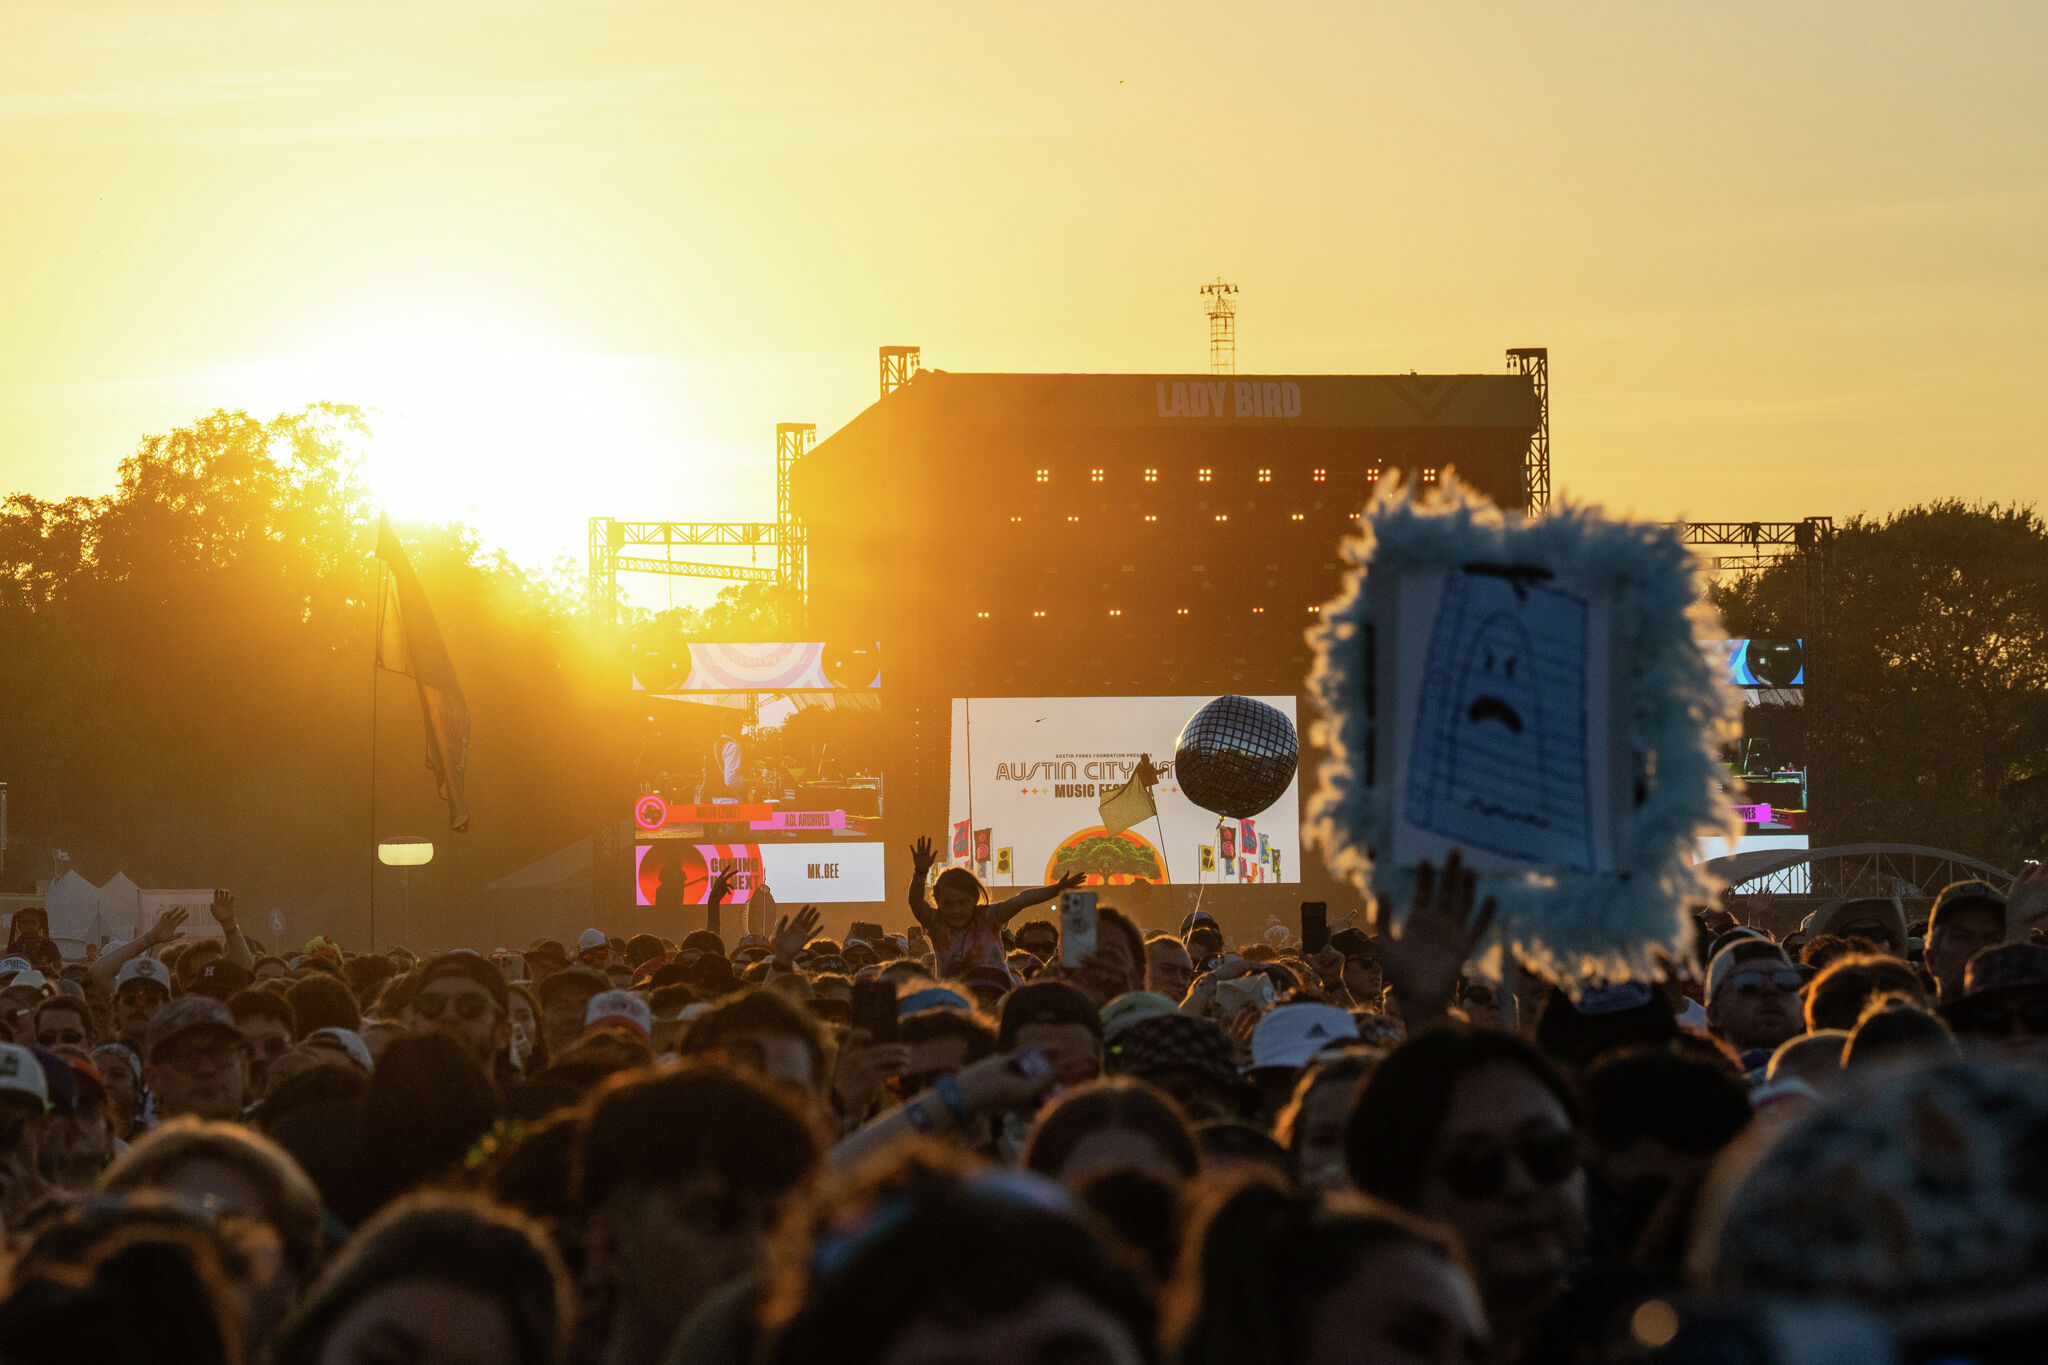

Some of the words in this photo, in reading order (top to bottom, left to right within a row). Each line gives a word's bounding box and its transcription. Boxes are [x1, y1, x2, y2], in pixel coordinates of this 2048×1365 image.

[1156, 381, 1226, 418] LADY
[1234, 381, 1301, 418] BIRD
[996, 761, 1077, 781] AUSTIN
[1084, 761, 1134, 780] CITY
[1054, 784, 1095, 798] MUSIC
[785, 814, 797, 827] ACL
[798, 813, 830, 826] ARCHIVES
[711, 857, 759, 873] COMING
[807, 863, 840, 879] MK.GEE
